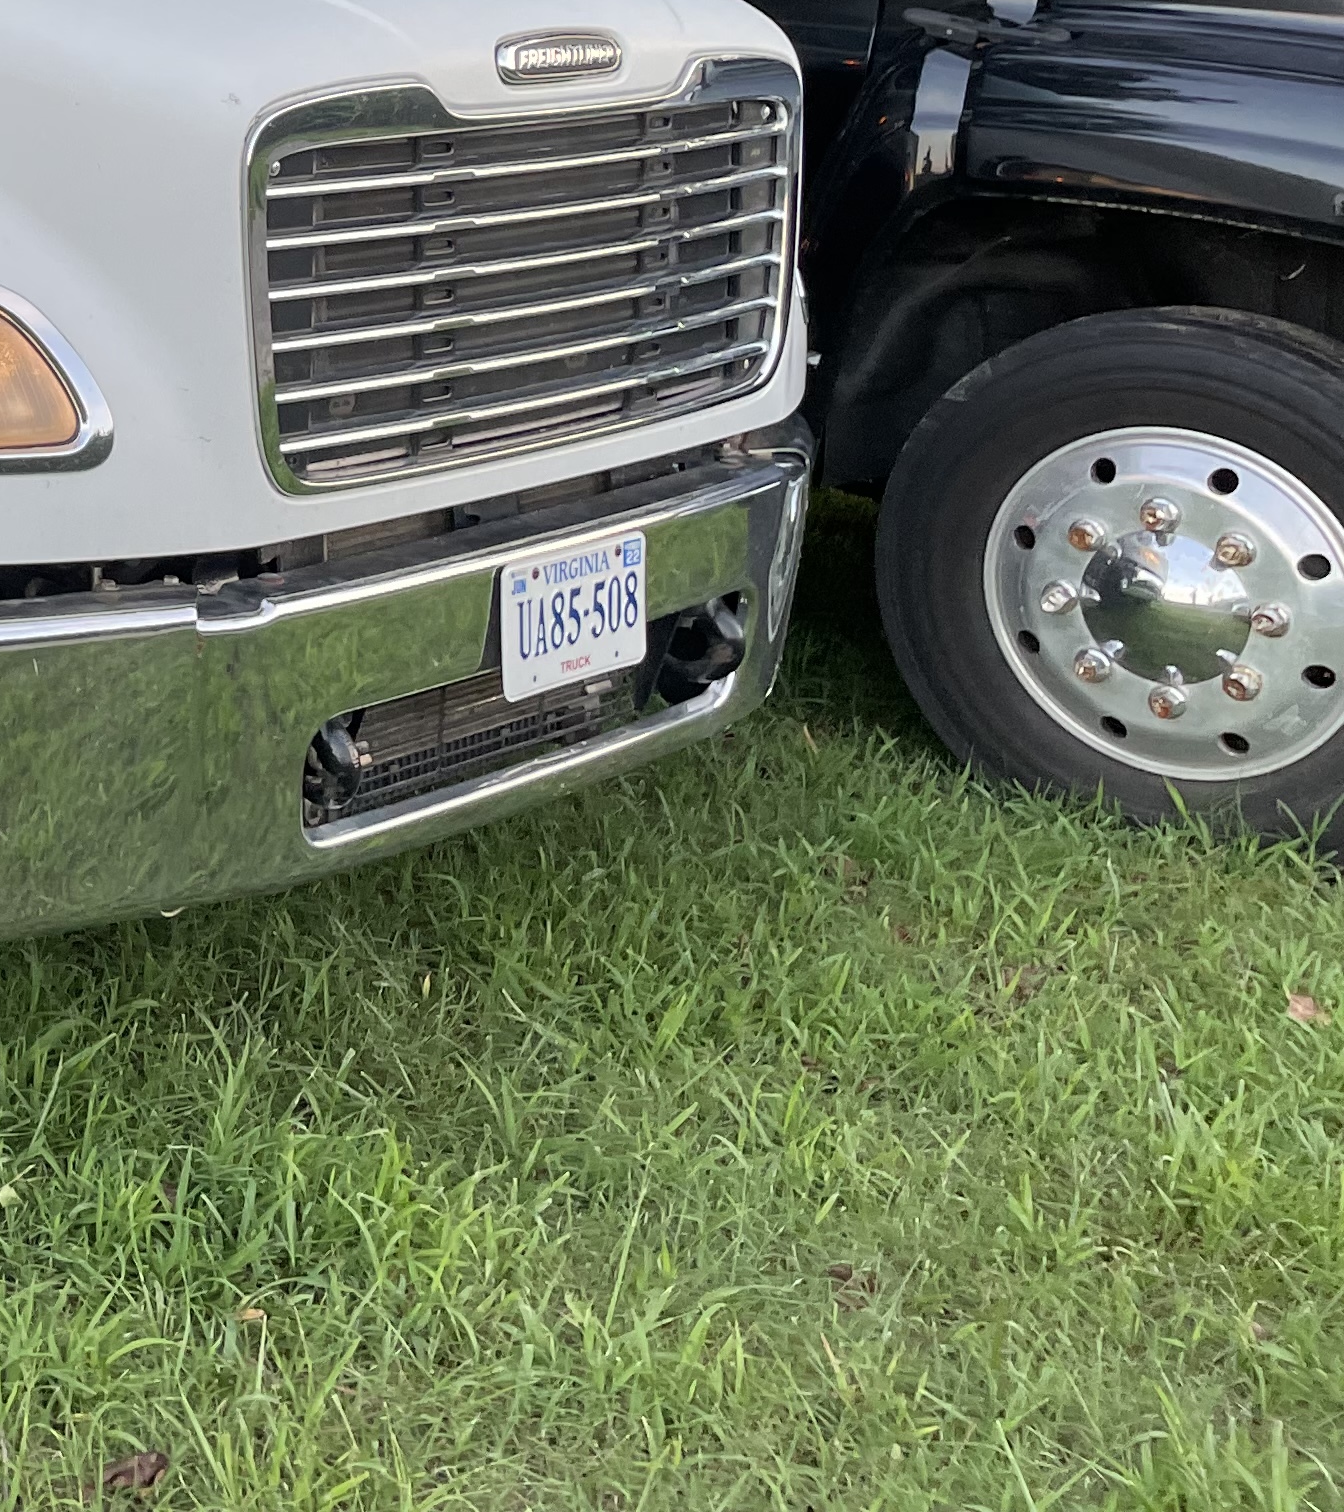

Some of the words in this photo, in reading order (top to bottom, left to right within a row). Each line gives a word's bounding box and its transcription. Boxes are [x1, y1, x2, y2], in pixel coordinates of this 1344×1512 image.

[543, 550, 610, 585] VIRGINIA
[625, 548, 640, 564] 22
[517, 570, 638, 660] UA85-508
[561, 654, 591, 674] TRUCK
